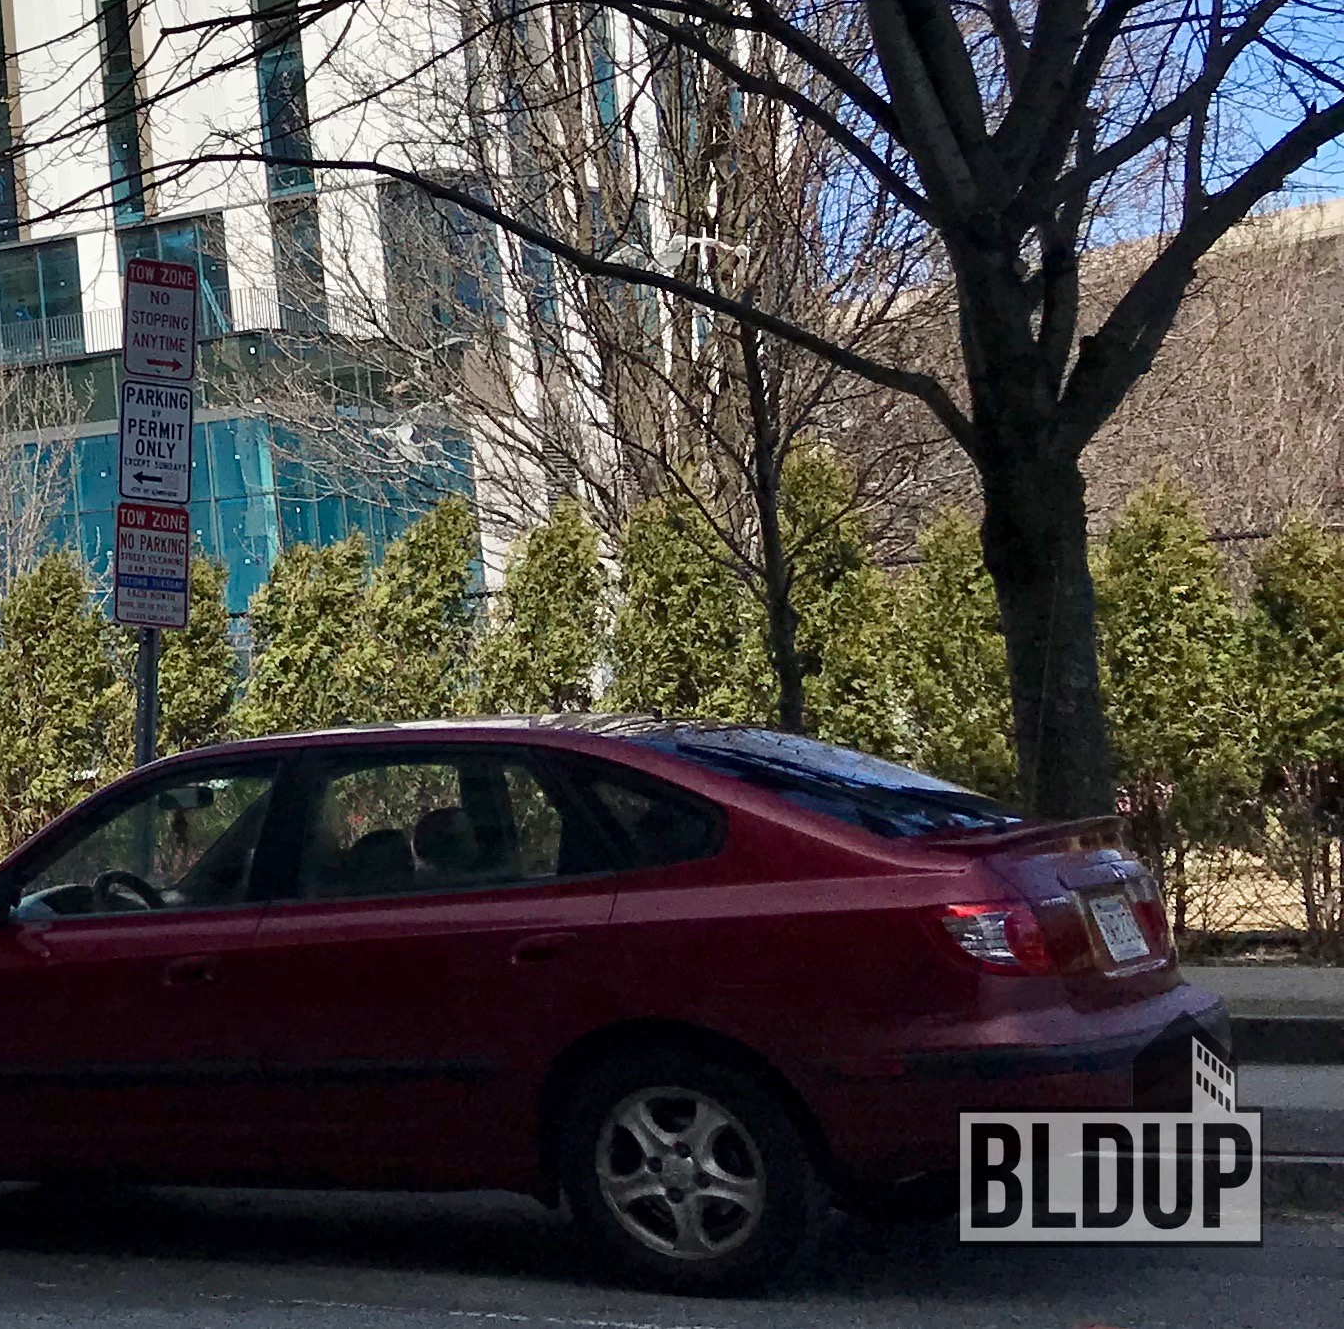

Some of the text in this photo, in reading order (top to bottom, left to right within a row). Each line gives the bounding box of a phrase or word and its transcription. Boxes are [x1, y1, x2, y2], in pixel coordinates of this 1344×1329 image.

[130, 264, 193, 287] TOW ZONE
[150, 290, 170, 306] NO
[131, 310, 189, 331] STOPPING
[132, 332, 187, 353] ANYTIME
[126, 386, 188, 410] PARKING
[128, 418, 184, 441] PERMIT
[135, 438, 176, 459] ONLY
[119, 509, 187, 531] TOW ZONE
[120, 533, 185, 555] NO PARKING
